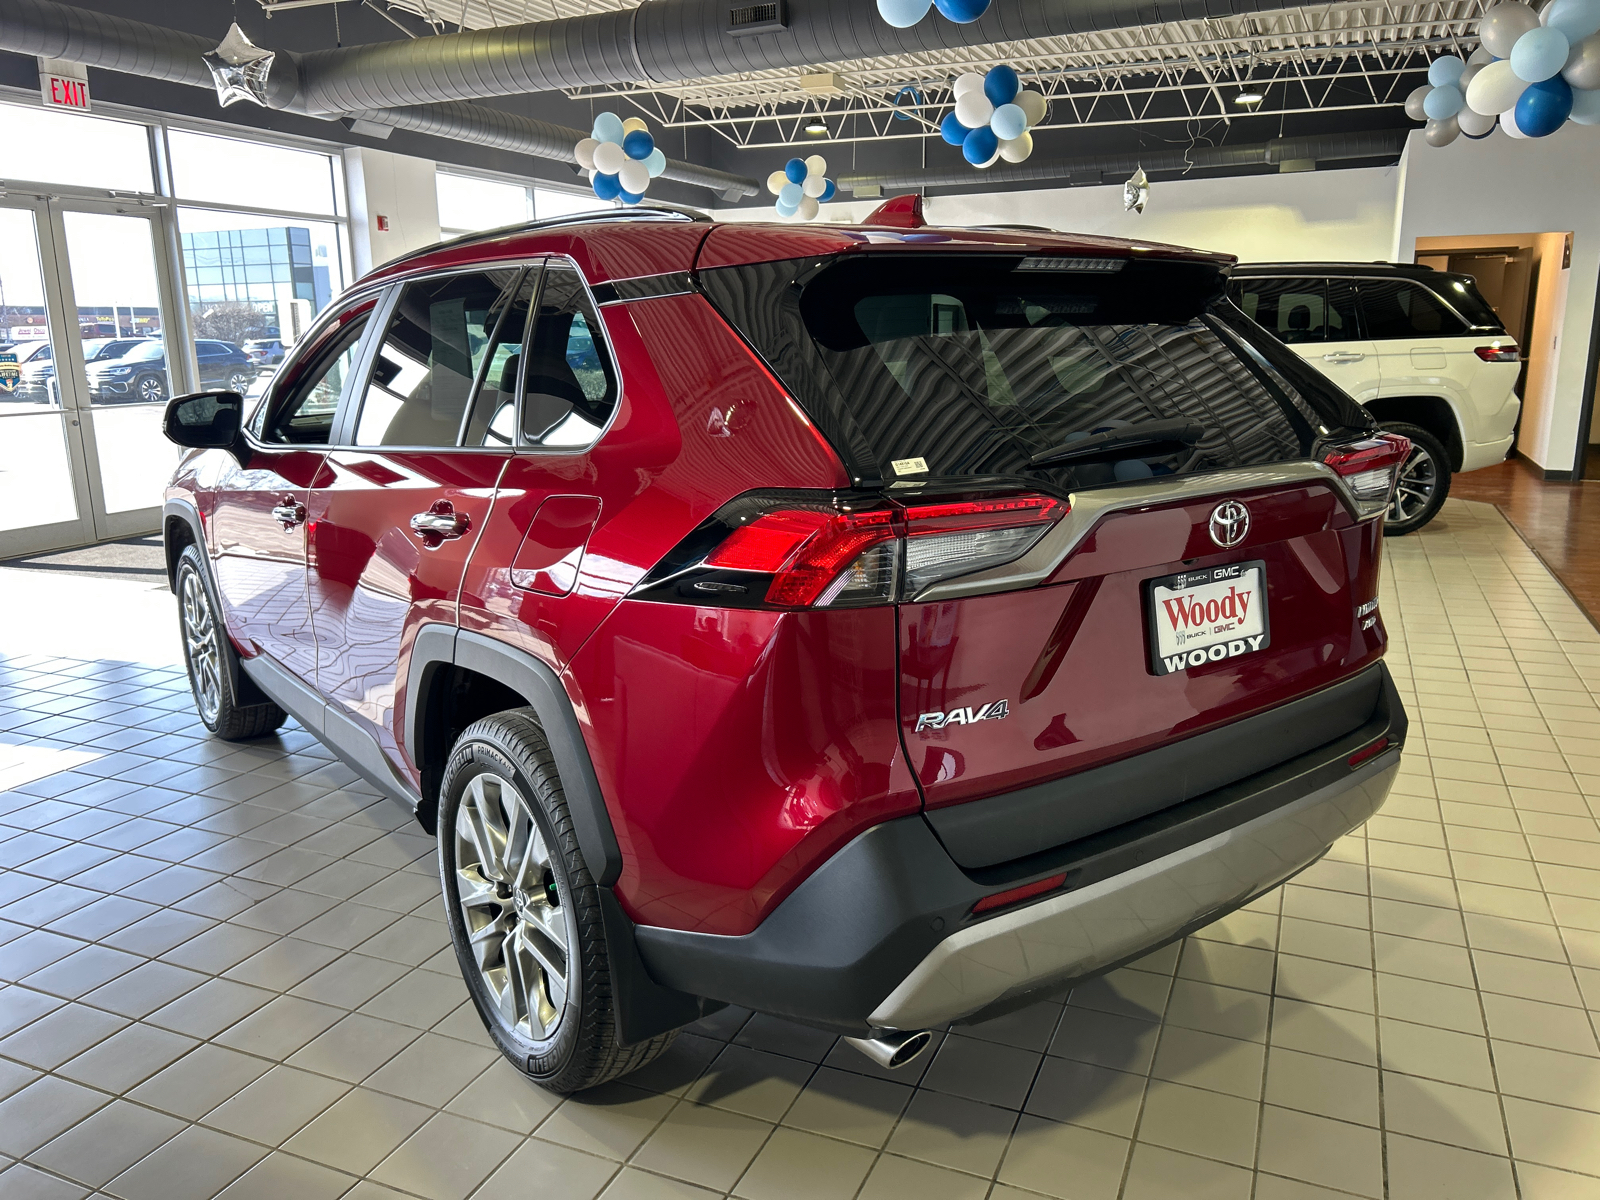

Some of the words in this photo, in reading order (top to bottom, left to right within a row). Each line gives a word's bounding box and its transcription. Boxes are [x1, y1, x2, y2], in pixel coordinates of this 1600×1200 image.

[50, 77, 86, 107] EXIT
[1188, 574, 1208, 582] BUICK
[1214, 566, 1240, 579] GMC
[1162, 586, 1252, 632] Woody
[1186, 630, 1207, 640] BUICK
[1213, 622, 1236, 634] GMC
[1163, 635, 1265, 673] WOODY
[915, 699, 1010, 732] RAV4
[443, 747, 473, 798] MICHELIN
[477, 746, 502, 765] PRIMACY
[529, 1041, 567, 1073] MICHELIN
